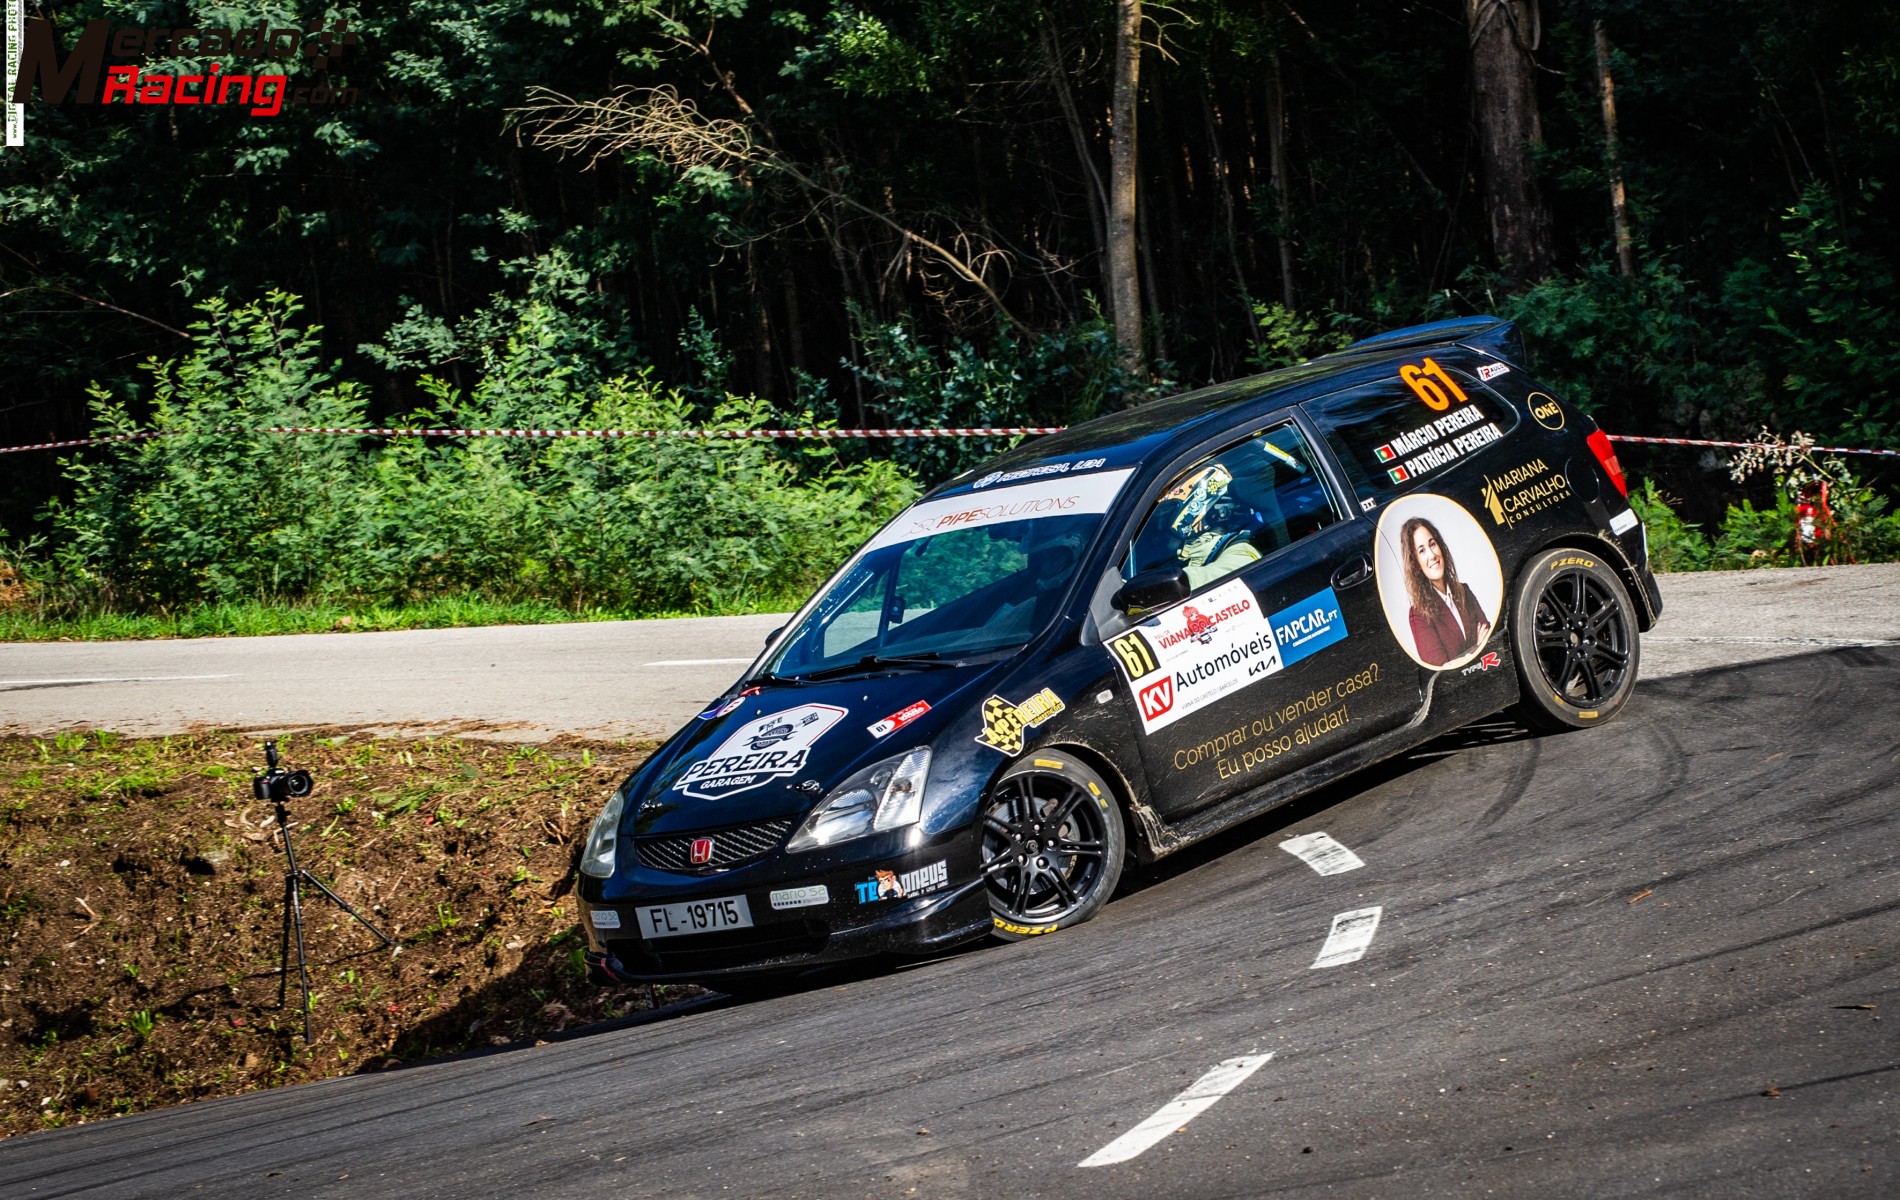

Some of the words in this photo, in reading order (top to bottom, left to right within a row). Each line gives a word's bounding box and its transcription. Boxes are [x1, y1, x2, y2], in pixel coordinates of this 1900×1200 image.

[1399, 357, 1469, 411] 61
[1534, 402, 1559, 420] ONE
[1390, 423, 1439, 457] MÁRCIO
[1432, 404, 1485, 437] PEREIRA
[1404, 442, 1459, 478] PATRÍCIA
[1452, 422, 1504, 455] PEREIRA
[1492, 458, 1549, 493] MARIANA
[1503, 474, 1566, 512] CARVALHO
[936, 496, 1080, 529] PIPESOLUTIONS
[1509, 490, 1571, 523] CONSULTORA
[1158, 628, 1192, 650] VIANA
[1208, 599, 1251, 628] CASTELO
[1276, 608, 1338, 646] FAPCAR.PT
[1114, 630, 1155, 678] 61
[1142, 682, 1170, 717] KV
[1176, 632, 1272, 692] Automóveis
[1174, 722, 1248, 771] Comprar
[1252, 715, 1274, 737] ou
[1277, 686, 1332, 726] vender
[1336, 663, 1380, 698] casa?
[1218, 758, 1240, 780] Eu
[1242, 734, 1291, 771] posso
[1295, 704, 1350, 746] ajudar!
[688, 750, 804, 779] PEREIRA
[700, 774, 756, 790] GARAGEM
[650, 900, 739, 933] FL-19715
